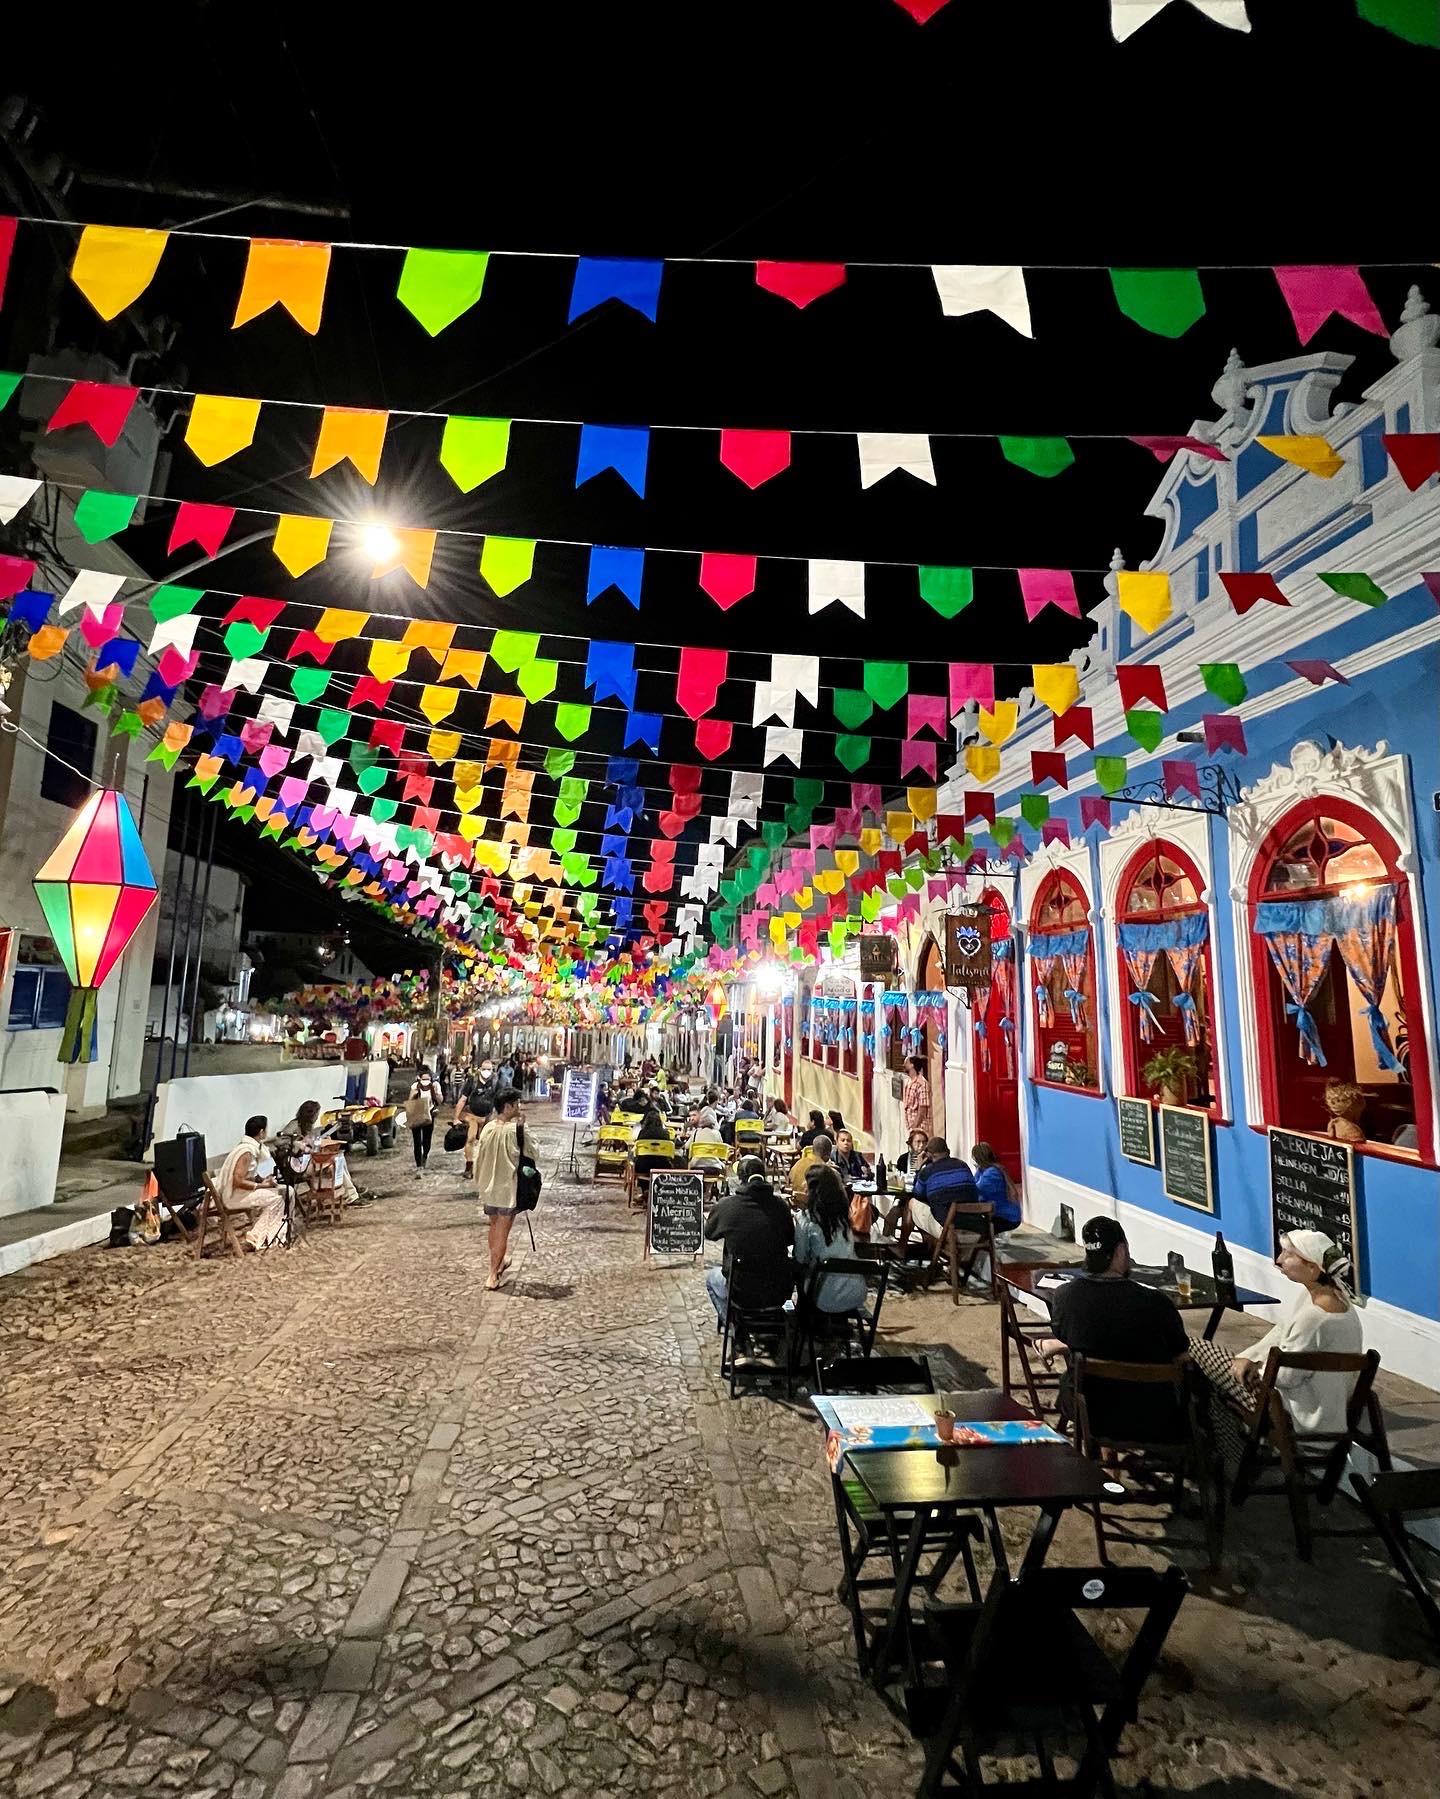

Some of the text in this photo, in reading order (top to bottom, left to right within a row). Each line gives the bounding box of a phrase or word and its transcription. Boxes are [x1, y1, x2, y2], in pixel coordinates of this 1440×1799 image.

[1279, 1135, 1337, 1162] CERVEJA
[1274, 1154, 1317, 1176] HEINEKEN
[1276, 1191, 1323, 1217] EISENBAHN
[1277, 1209, 1317, 1232] BOHEMIA
